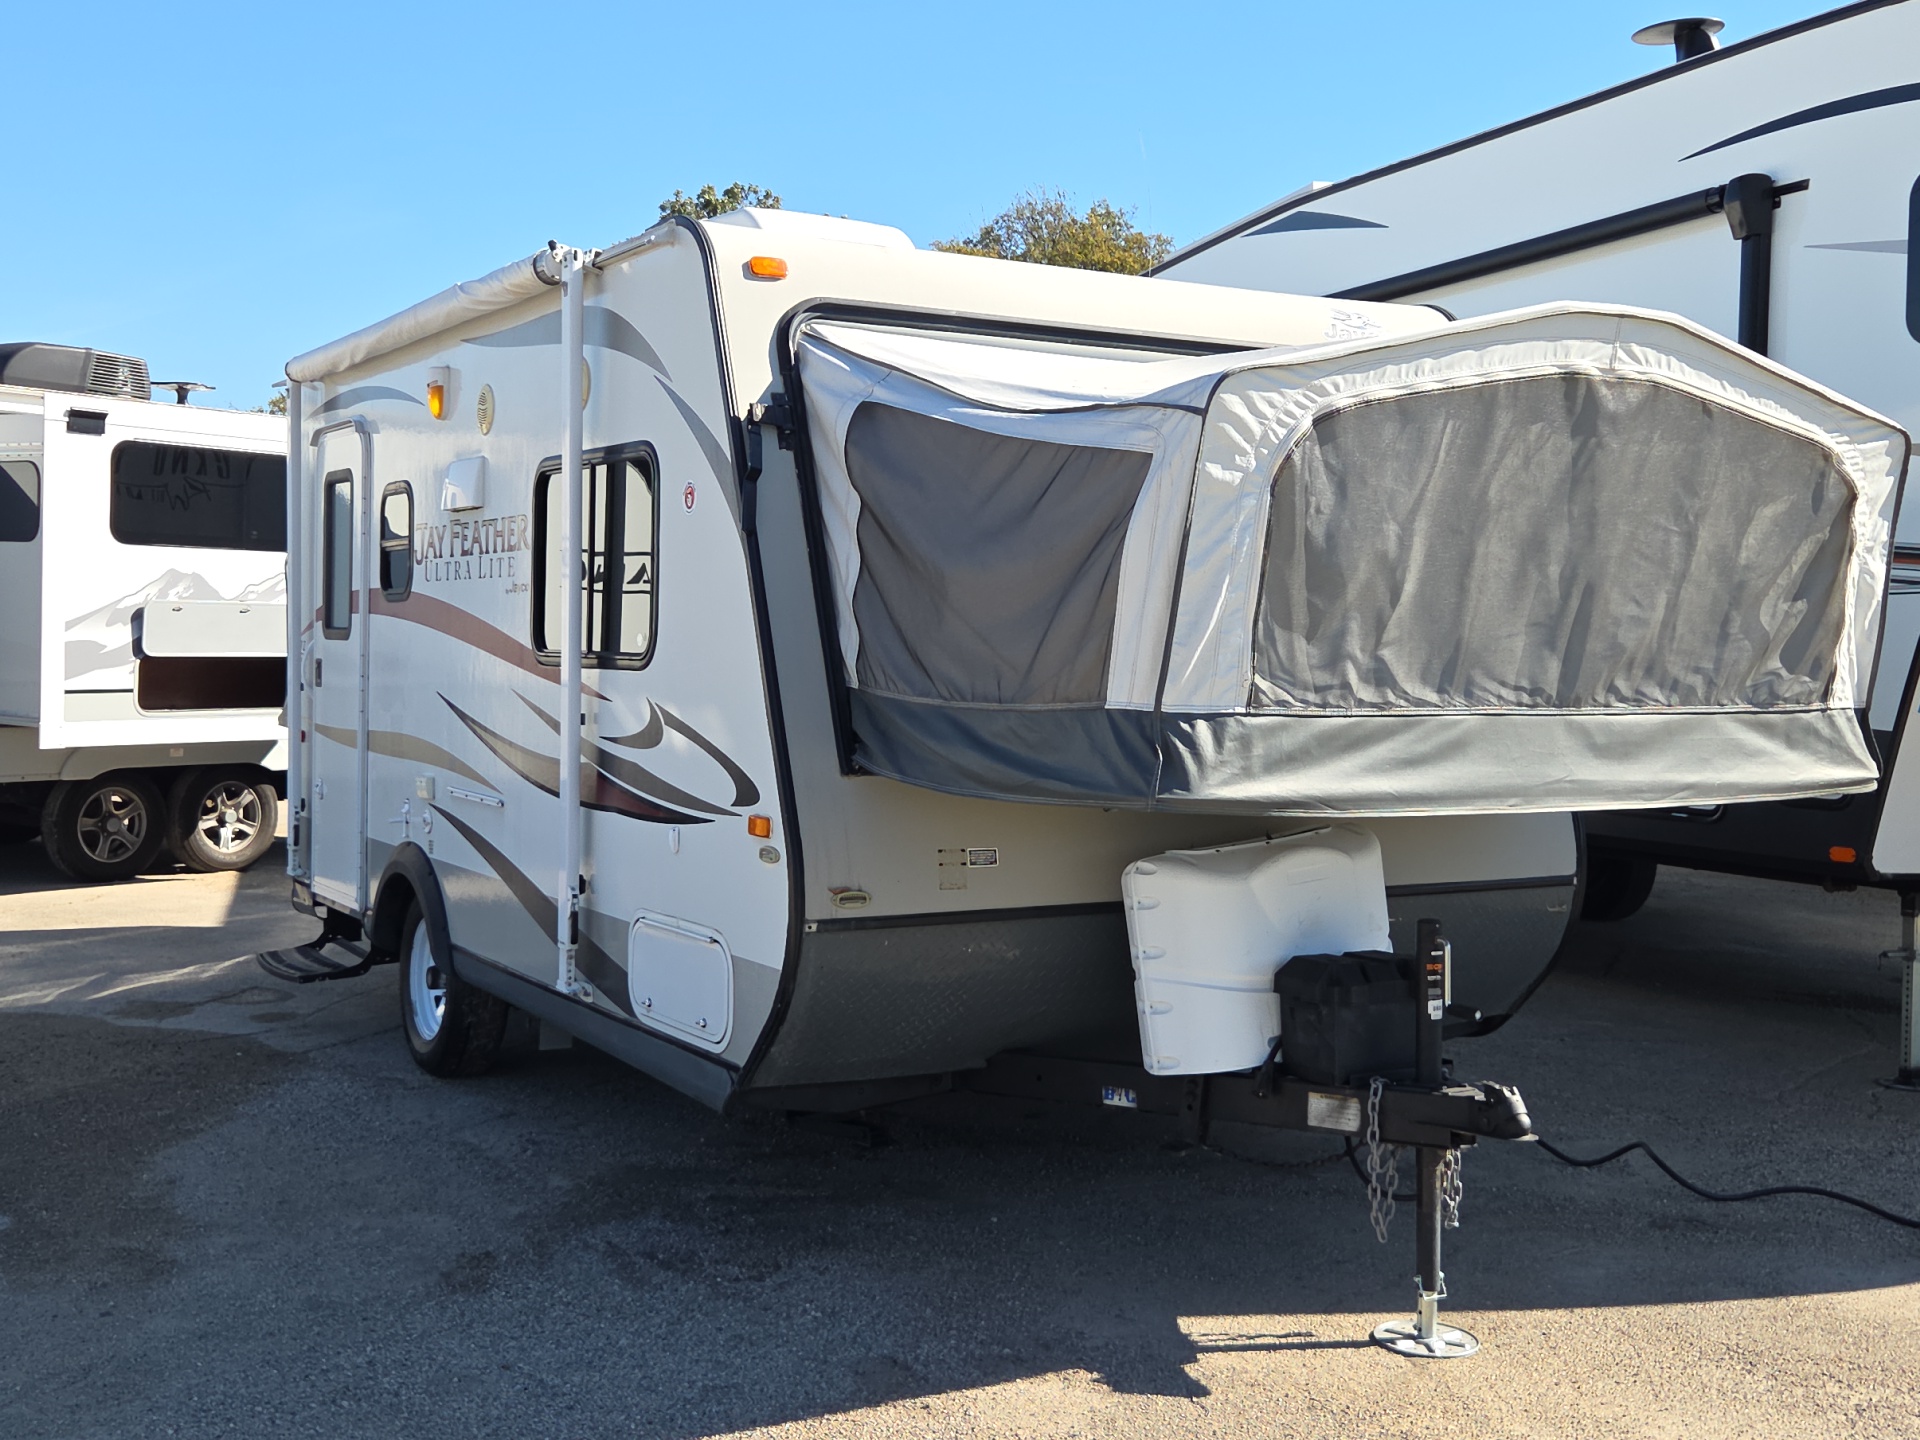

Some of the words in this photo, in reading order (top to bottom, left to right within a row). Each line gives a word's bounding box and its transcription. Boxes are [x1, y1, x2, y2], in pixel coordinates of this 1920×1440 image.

[414, 522, 447, 566] JAY
[449, 513, 531, 558] FEATHER
[424, 559, 472, 583] ULTRA
[478, 555, 516, 579] LITE
